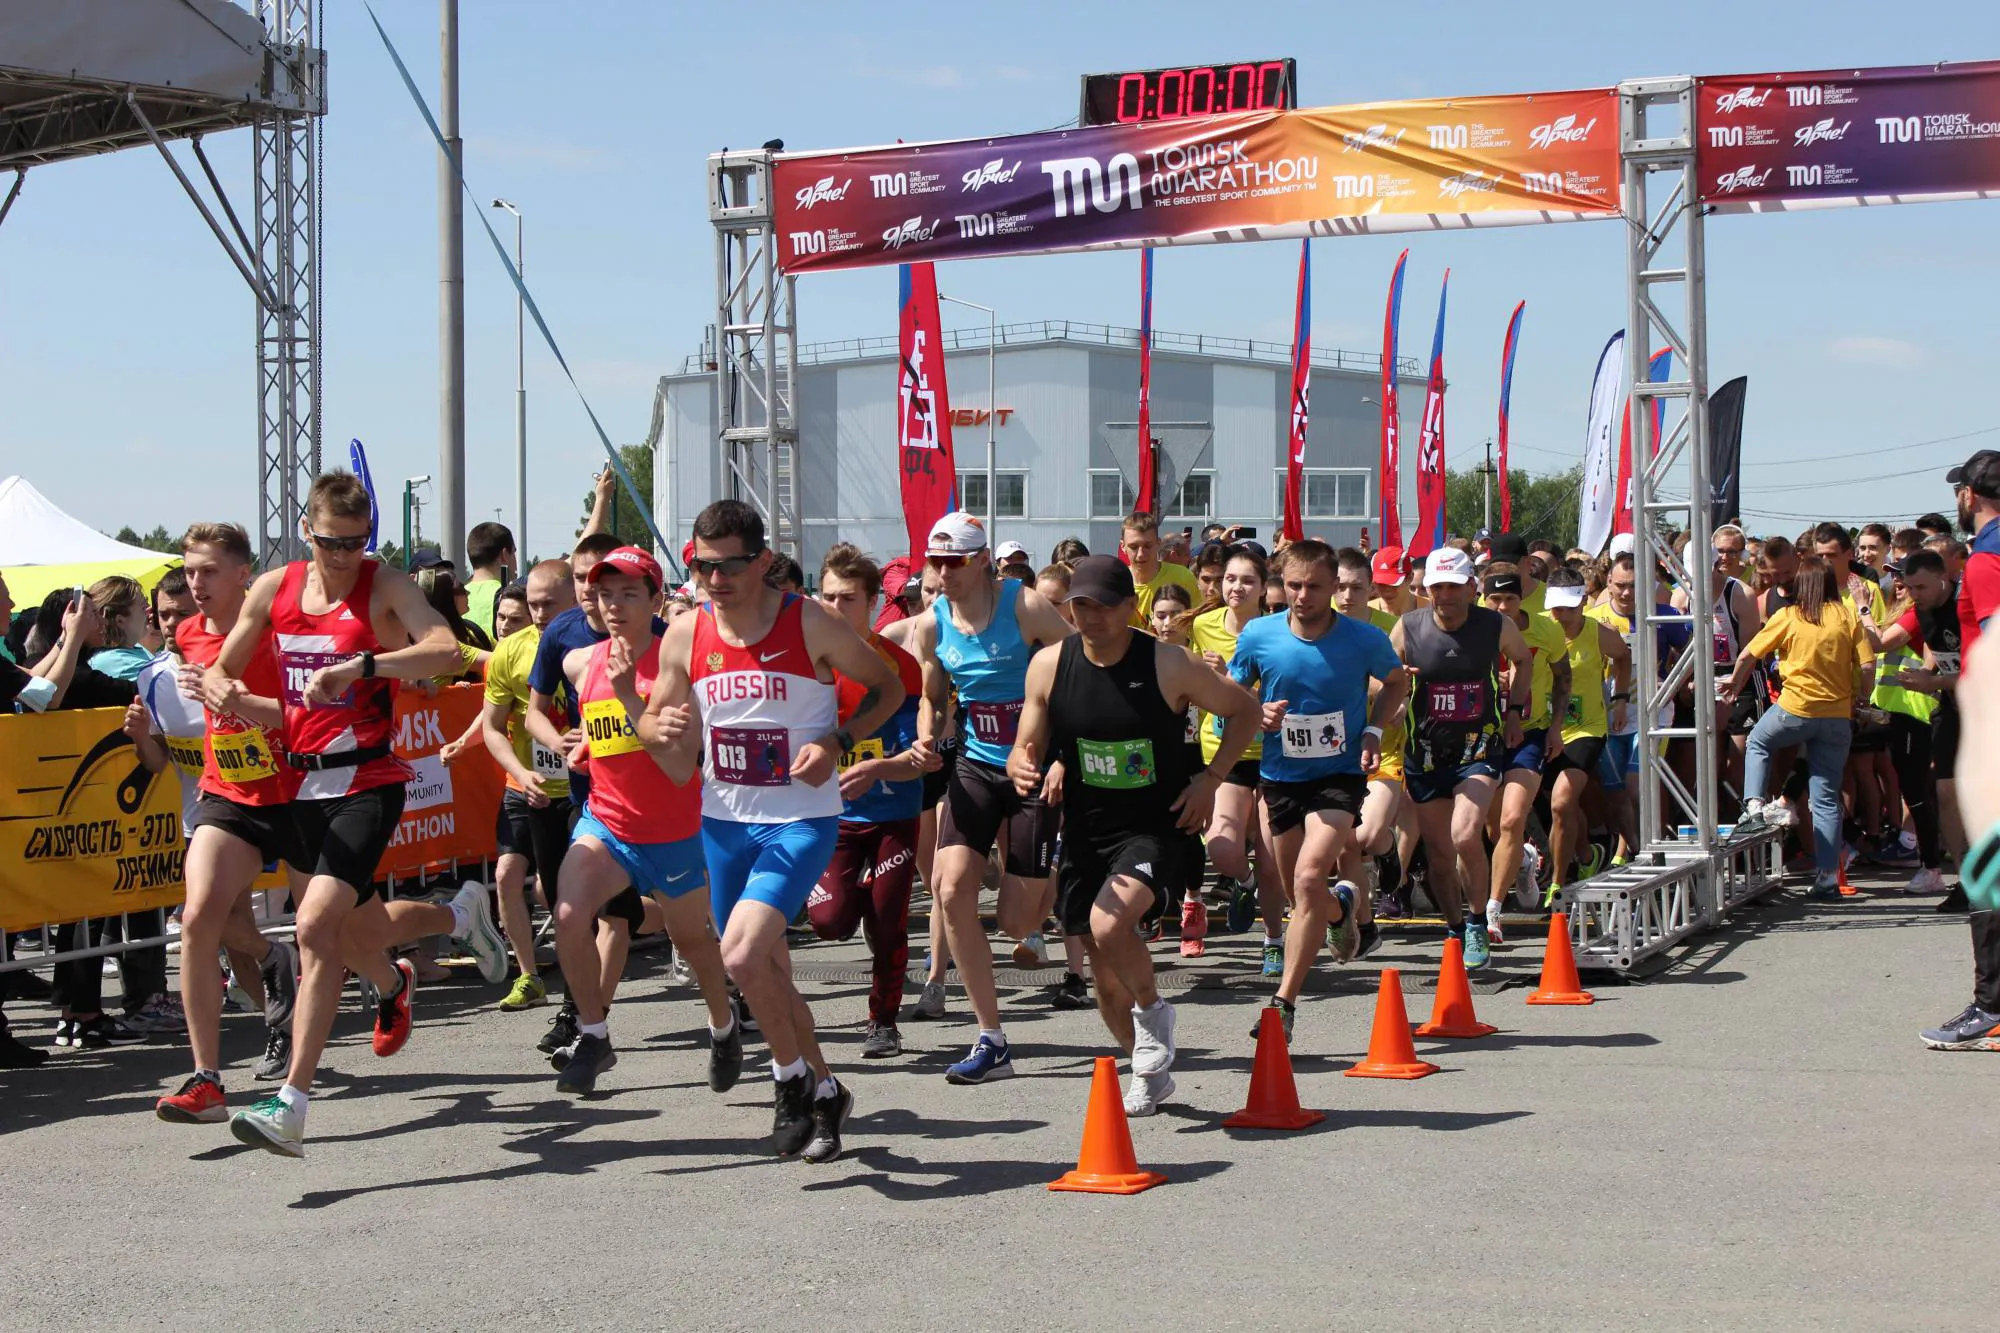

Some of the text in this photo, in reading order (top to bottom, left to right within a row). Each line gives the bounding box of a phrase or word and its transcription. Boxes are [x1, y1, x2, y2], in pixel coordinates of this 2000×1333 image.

[1117, 61, 1285, 122] 0:00:00
[1715, 85, 1773, 114] Ярче!
[1528, 114, 1597, 150] Ярче!
[1793, 117, 1852, 147] Ярче!
[1923, 113, 1970, 126] TOMSK
[1924, 122, 2000, 137] MARATHON
[1145, 139, 1249, 172] TOMSK
[909, 174, 940, 182] GREATEST
[909, 181, 929, 189] SPORT
[909, 184, 946, 195] COMMUNITY
[961, 157, 1022, 193] Ярче!
[1151, 156, 1318, 197] MARATHON
[1716, 164, 1773, 193] Ярче!
[795, 176, 852, 211] Ярче!
[1154, 199, 1171, 208] THE
[1173, 194, 1217, 206] GREATEST
[1220, 190, 1248, 201] SPORT
[1250, 184, 1303, 198] COMMUNITY
[882, 216, 941, 251] Ярче!
[949, 409, 1014, 427] БИТ
[706, 675, 787, 706] RUSSIA
[1433, 694, 1456, 711] 775
[390, 709, 447, 752] MSK
[586, 716, 622, 742] 4004
[1286, 728, 1312, 747] 451
[214, 748, 244, 769] 6007
[536, 750, 563, 769] 345
[718, 744, 747, 771] 813
[1084, 752, 1118, 776] 642
[24, 818, 122, 859] СКОРОСТЬ
[140, 812, 177, 849] ЭТО
[387, 811, 455, 848] ATHON
[113, 850, 187, 892] ПРЕИМУ
